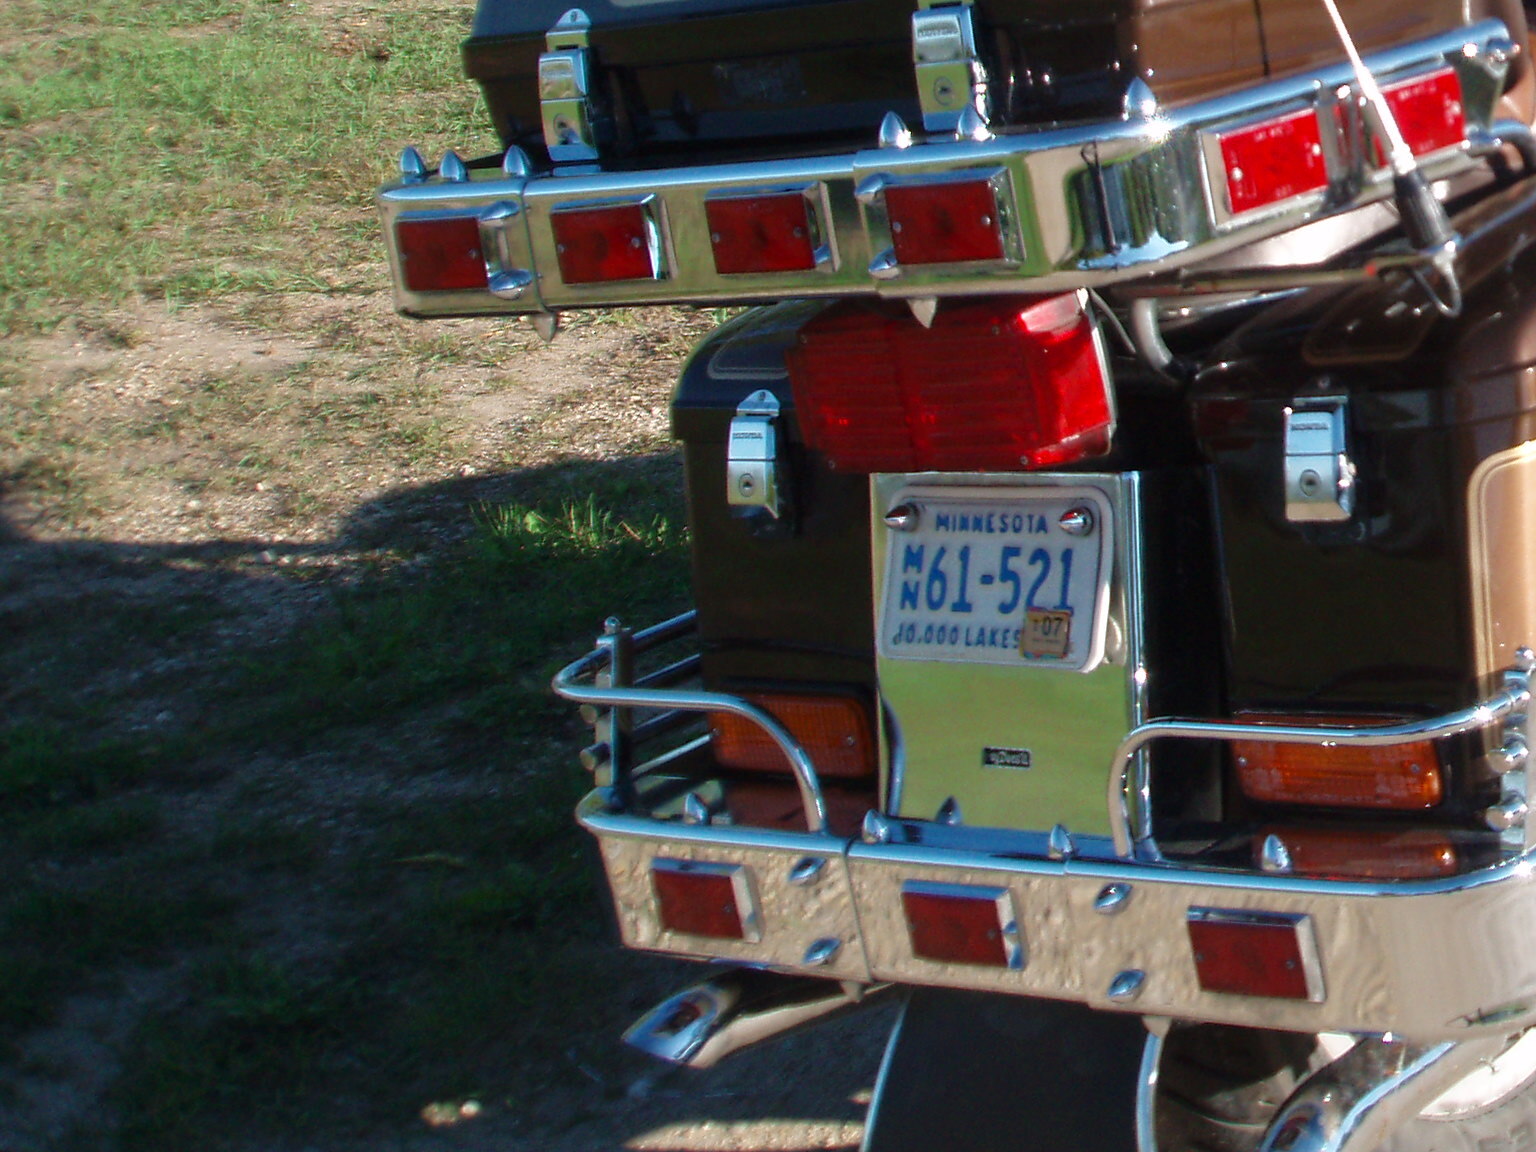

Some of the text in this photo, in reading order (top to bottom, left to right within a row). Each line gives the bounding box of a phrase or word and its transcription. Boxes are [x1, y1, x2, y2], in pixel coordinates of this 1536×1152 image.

[935, 513, 1049, 535] MINNESOTA
[925, 545, 1074, 615] 61-521
[964, 627, 1021, 649] LAKES
